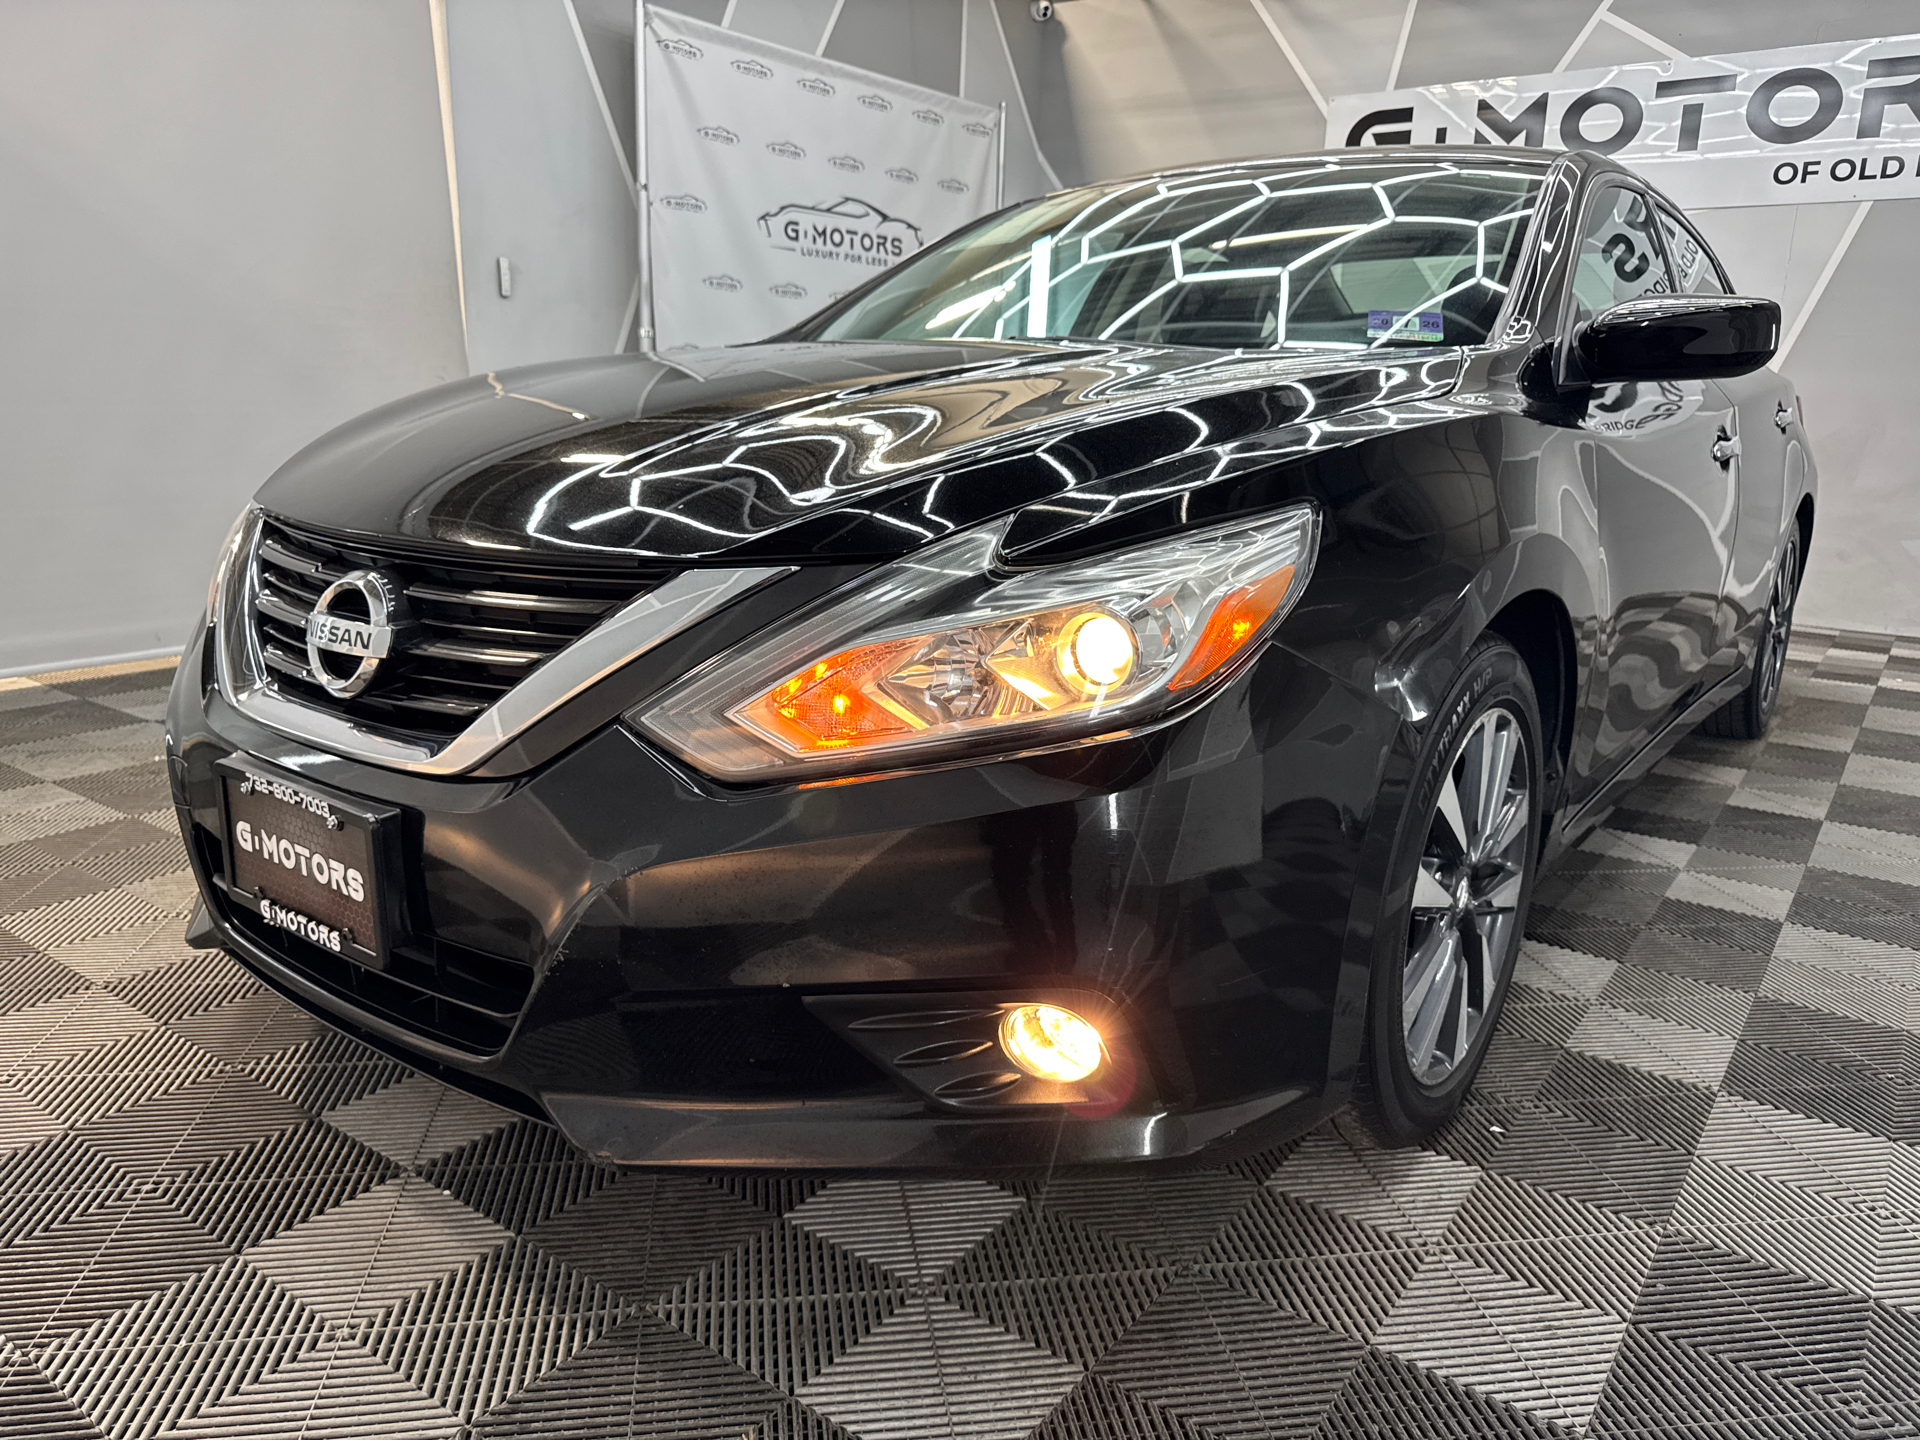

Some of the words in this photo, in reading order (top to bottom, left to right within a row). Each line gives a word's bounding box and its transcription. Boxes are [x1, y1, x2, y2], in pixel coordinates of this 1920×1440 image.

[1773, 160, 1821, 185] OF
[1830, 155, 1906, 182] OLD
[800, 247, 840, 261] LUXURY
[844, 253, 863, 265] FOR
[865, 255, 889, 268] LESS
[307, 618, 373, 651] NISSAN
[245, 772, 331, 818] 732-800-7003
